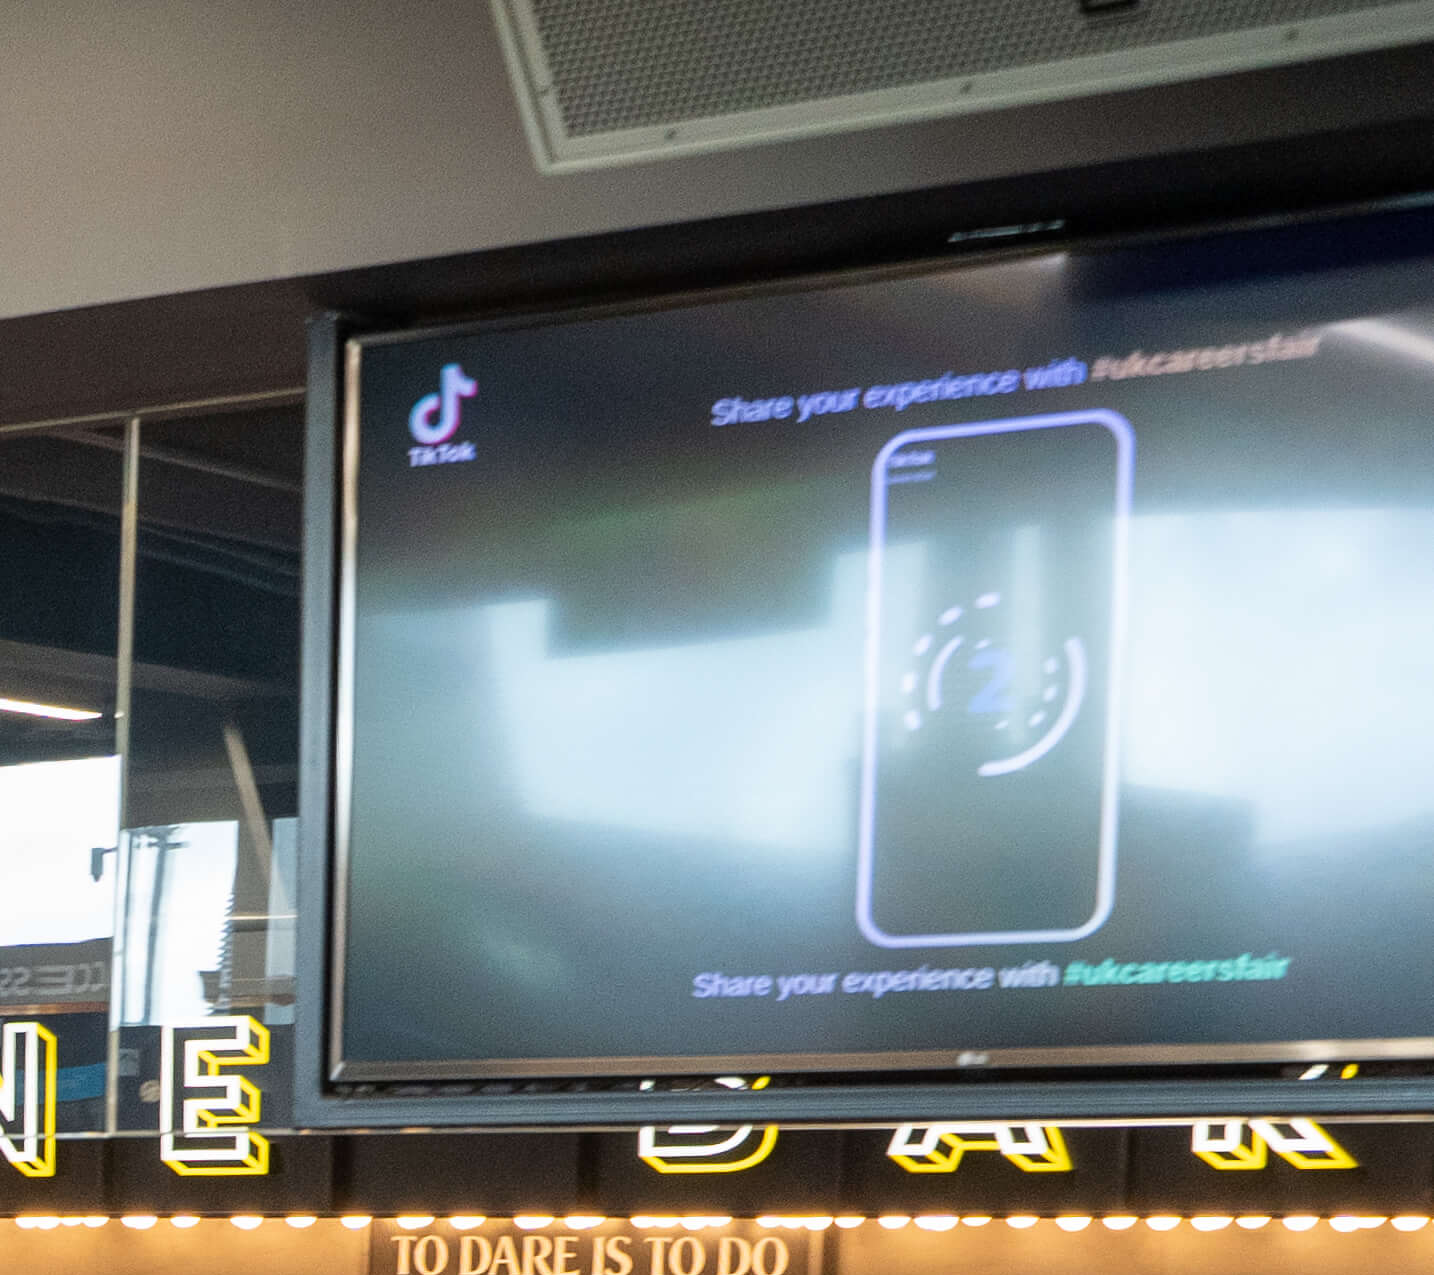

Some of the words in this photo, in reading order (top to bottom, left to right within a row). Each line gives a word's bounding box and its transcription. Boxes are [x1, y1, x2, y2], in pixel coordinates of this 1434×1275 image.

[711, 397, 793, 426] Share
[796, 388, 861, 422] your
[863, 368, 1021, 411] experience
[1023, 356, 1088, 391] with
[408, 441, 478, 468] TikTok
[692, 971, 772, 998] Share
[776, 972, 838, 1001] your
[842, 962, 995, 999] experience
[998, 959, 1061, 988] with
[1063, 952, 1293, 987] #ukcareersfair
